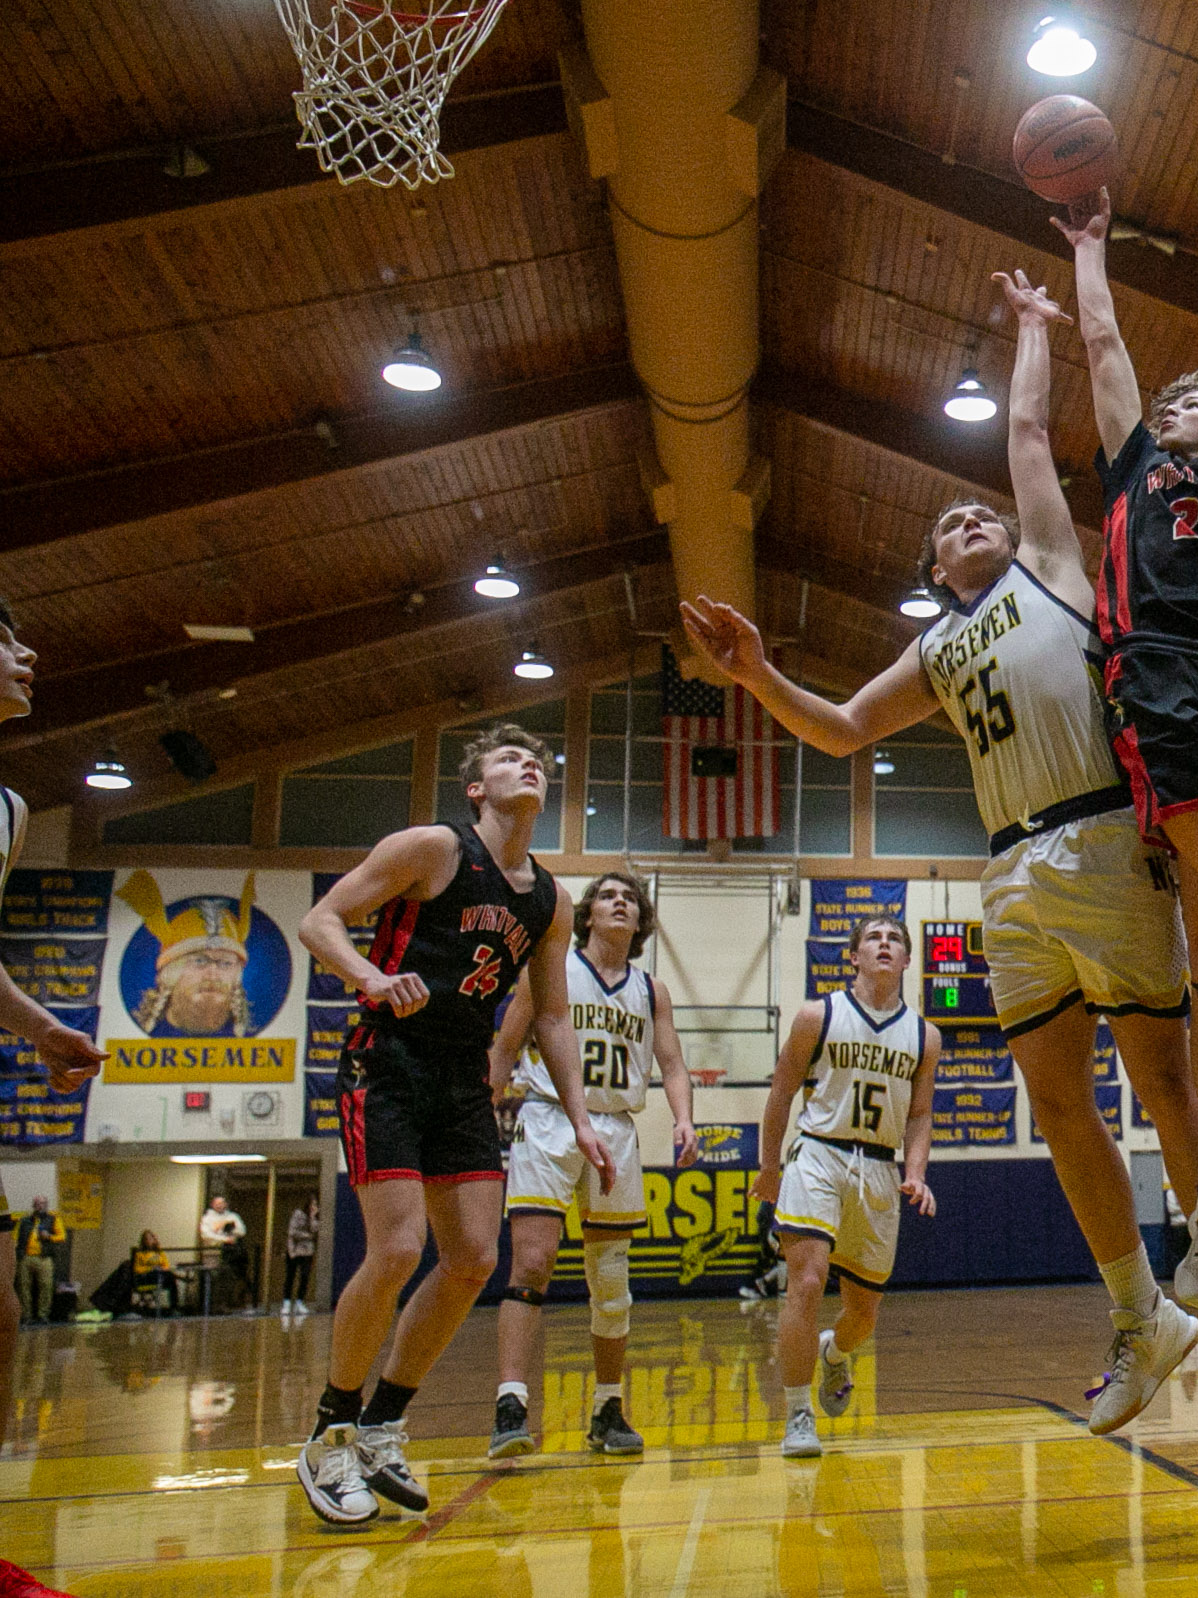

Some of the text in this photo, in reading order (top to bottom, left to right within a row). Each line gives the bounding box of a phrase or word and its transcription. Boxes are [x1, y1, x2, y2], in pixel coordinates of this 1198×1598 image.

[933, 591, 1022, 698] RSEMEN
[959, 656, 1016, 758] 55
[815, 903, 842, 914] STATE
[820, 919, 851, 931] BOYS
[926, 923, 965, 936] HOME
[932, 936, 962, 961] 29
[938, 962, 967, 973] BONUS
[933, 977, 959, 988] FOULS
[945, 987, 958, 1008] 8
[568, 1003, 646, 1044] ORSEMEN
[116, 1047, 284, 1068] NORSEMEN
[583, 1038, 629, 1090] 20
[937, 1063, 995, 1077] FOOTBALL
[851, 1080, 887, 1132] 15
